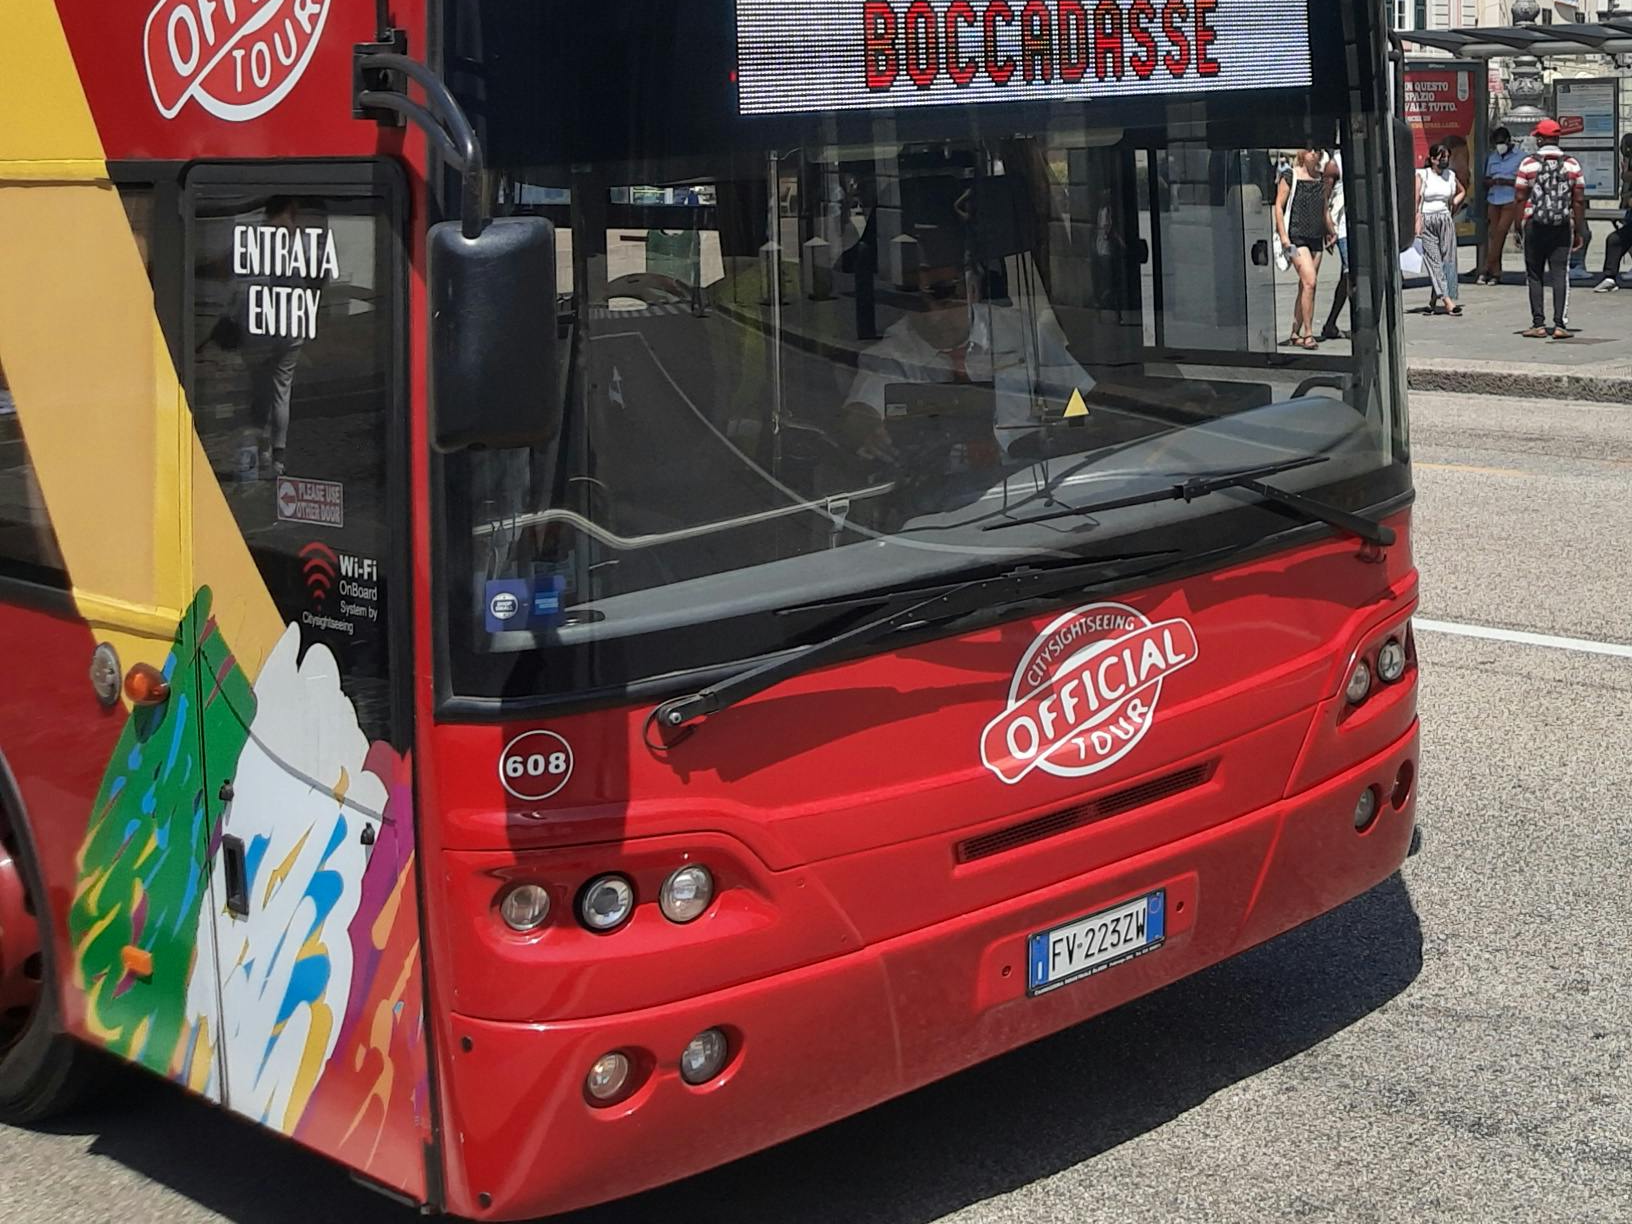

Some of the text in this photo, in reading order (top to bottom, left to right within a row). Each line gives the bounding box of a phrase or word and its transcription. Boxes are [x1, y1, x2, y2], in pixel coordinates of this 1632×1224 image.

[1404, 92, 1435, 102] SPAZIO
[1414, 82, 1448, 92] QUESTO
[1404, 102, 1427, 112] VALE
[233, 225, 339, 280] ENTRATA
[248, 285, 321, 339] ENTRY
[298, 482, 341, 503] PLEASE USE
[296, 502, 341, 523] OTHER DOOR
[339, 555, 377, 581] Wi-Fi
[339, 580, 377, 601] OnBoard
[302, 611, 354, 636] Citysightseeing
[340, 601, 377, 621] System by
[1028, 614, 1135, 686] CITYSIGHTSEEING
[1006, 629, 1186, 760] OFFICIAL
[1071, 698, 1148, 760] TOUR
[505, 752, 567, 777] 608
